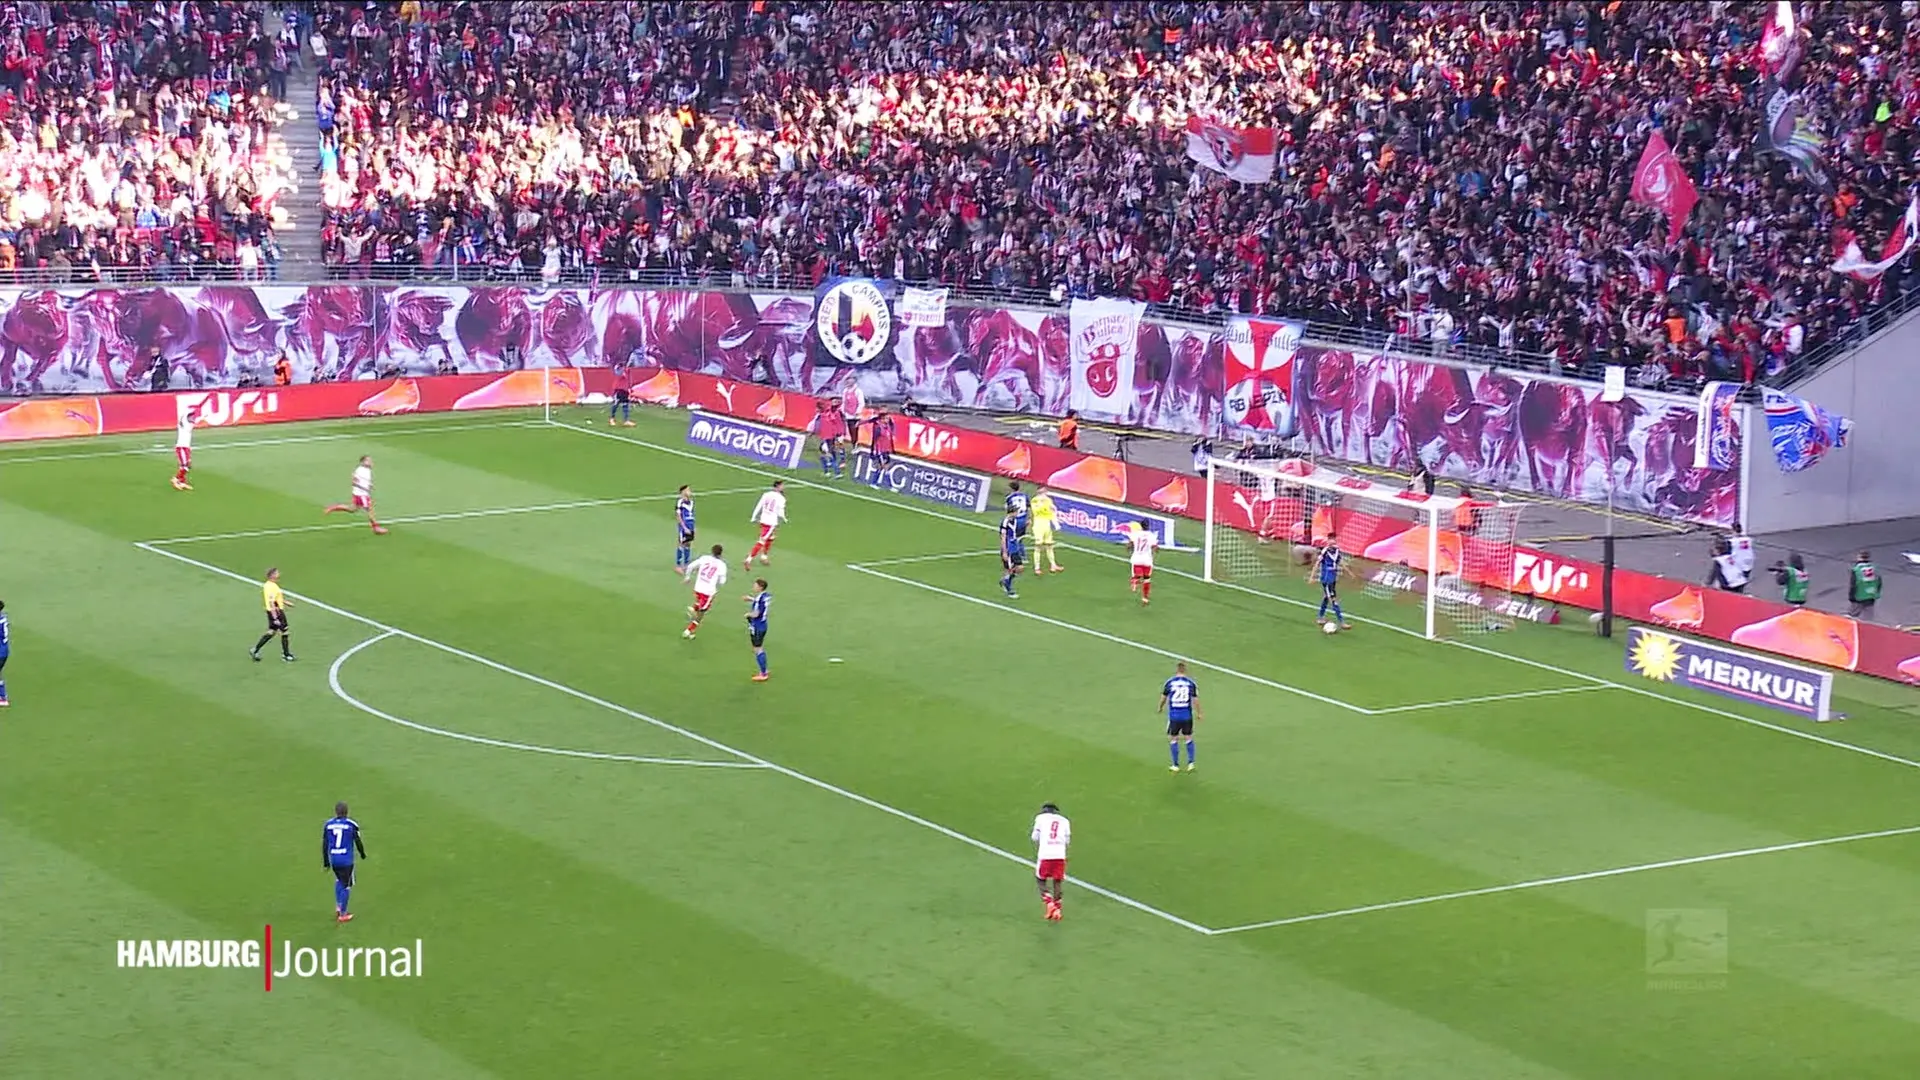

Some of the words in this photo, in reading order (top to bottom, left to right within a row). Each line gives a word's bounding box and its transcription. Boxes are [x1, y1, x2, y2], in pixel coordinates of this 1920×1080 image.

[820, 296, 837, 325] RED
[851, 284, 888, 330] CAMPUS
[711, 424, 792, 461] kraken
[914, 468, 966, 491] HOTELS
[911, 482, 974, 506] RESORTS
[1077, 509, 1108, 534] Bull
[1687, 655, 1815, 706] MERKUR
[332, 828, 343, 849] 7
[1049, 821, 1059, 840] 9
